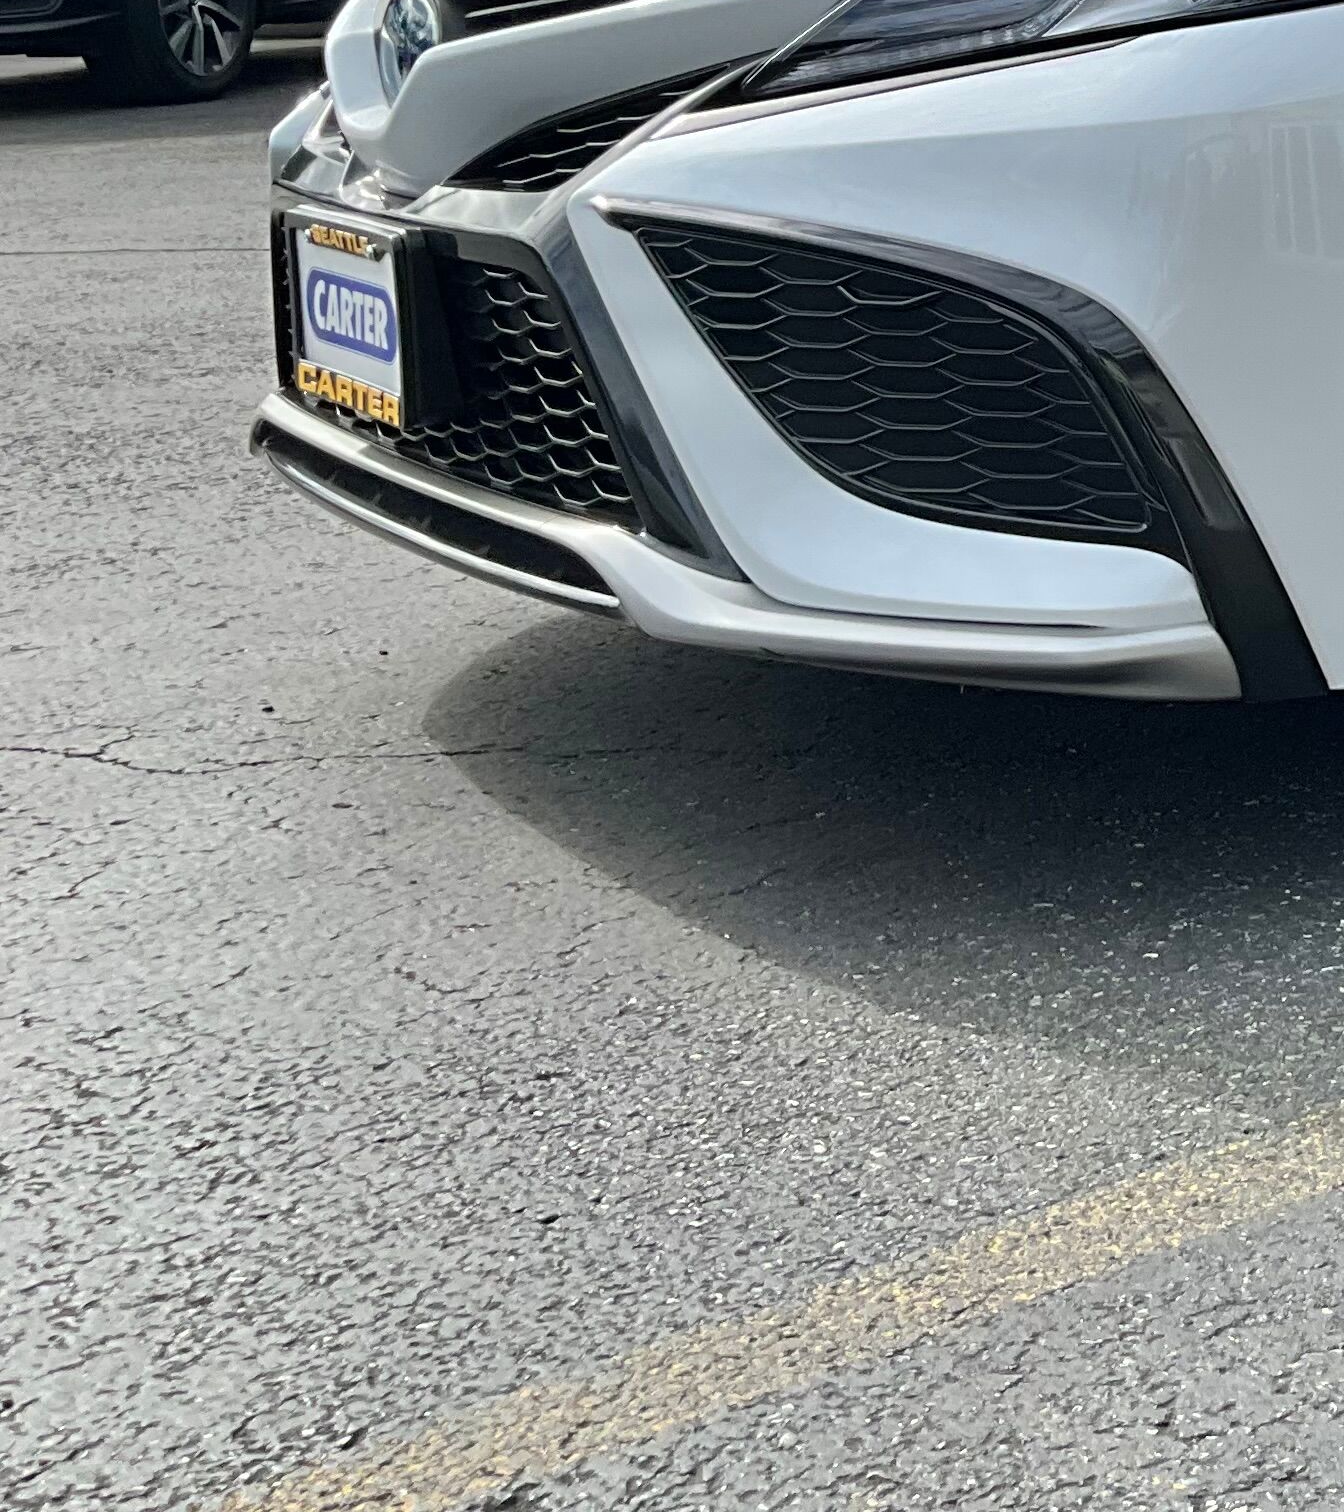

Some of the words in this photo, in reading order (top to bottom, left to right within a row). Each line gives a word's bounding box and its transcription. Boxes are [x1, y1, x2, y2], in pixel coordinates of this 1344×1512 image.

[310, 223, 369, 257] SEATTLE
[313, 279, 388, 350] CARTER
[298, 363, 400, 426] CARTER
